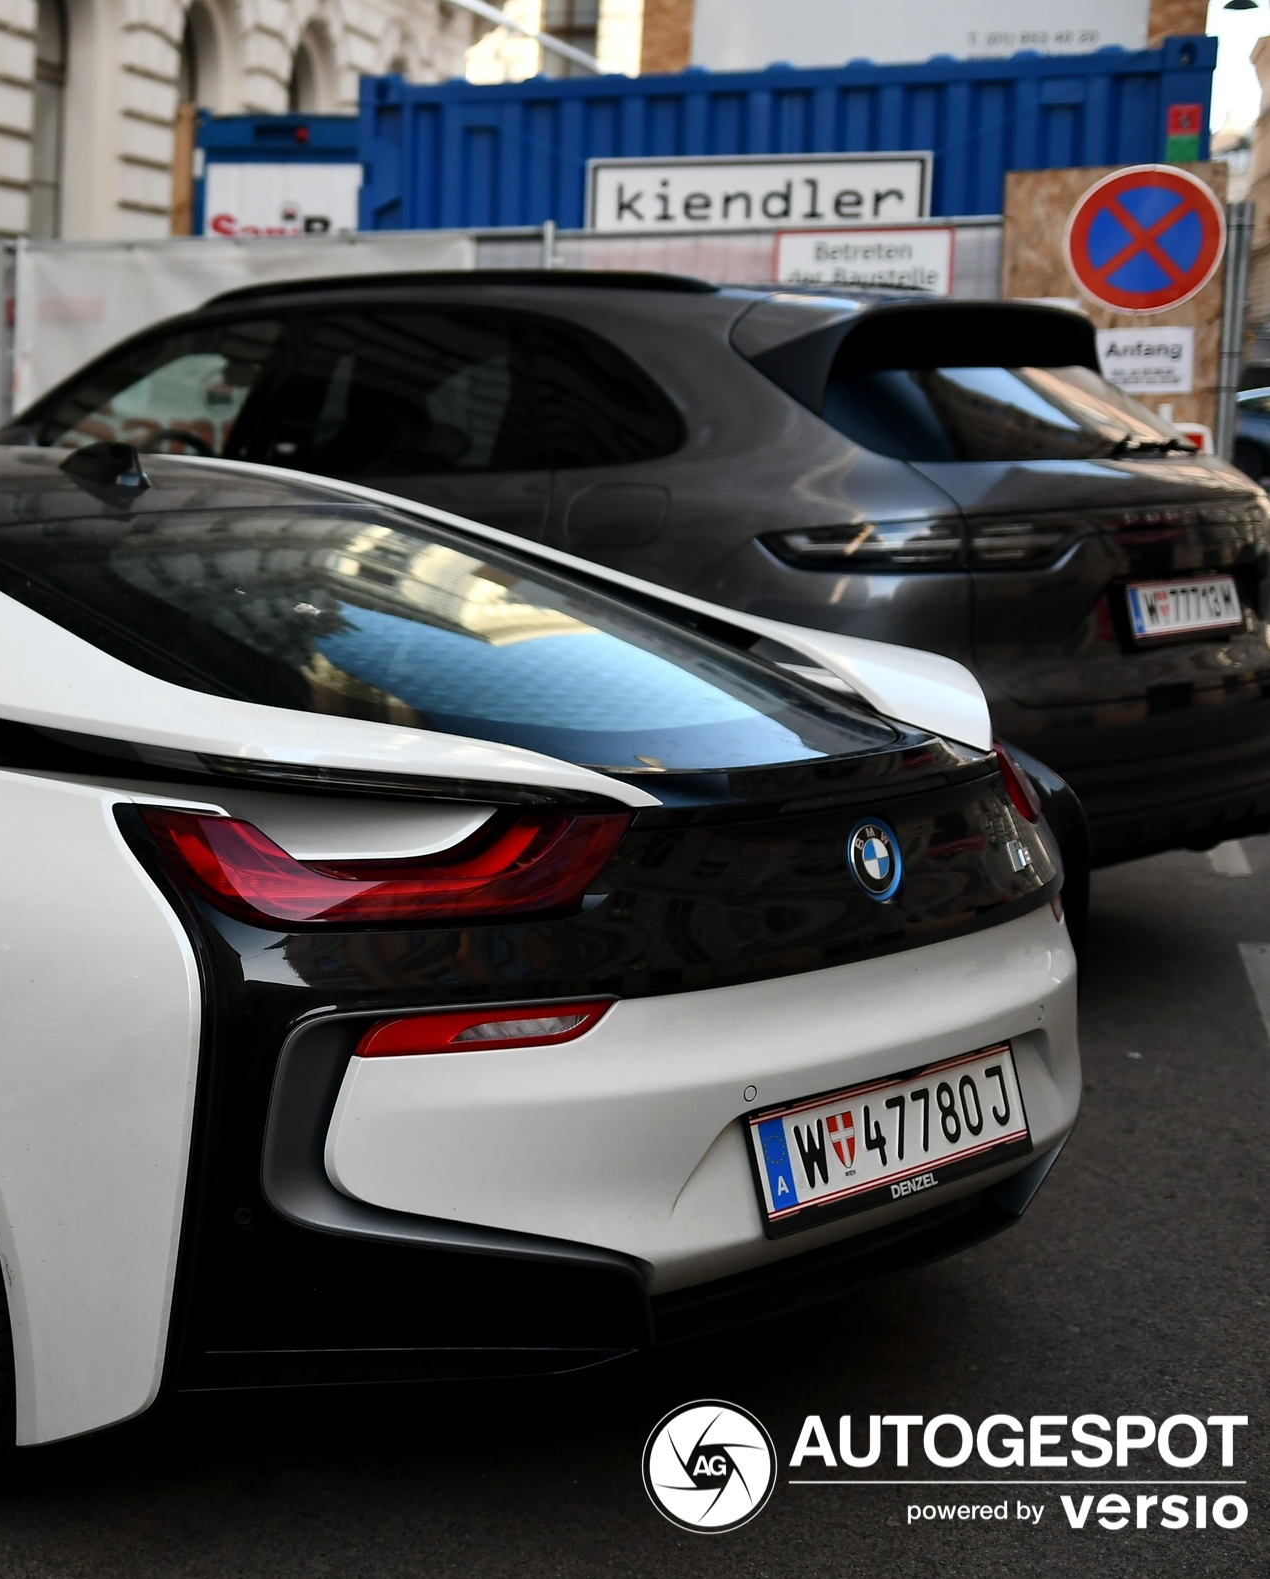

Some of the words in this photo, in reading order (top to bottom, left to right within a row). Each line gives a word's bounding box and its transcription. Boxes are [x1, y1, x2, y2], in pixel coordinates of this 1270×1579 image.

[616, 178, 905, 222] kiendler
[815, 240, 914, 261] Betreten
[1106, 341, 1183, 360] Anfang
[1143, 592, 1160, 624] W
[855, 826, 890, 850] BMW
[793, 1118, 829, 1189] W
[862, 1074, 983, 1167] 47780
[984, 1065, 1011, 1126] J
[777, 1174, 790, 1197] A
[890, 1173, 939, 1200] DENZEL
